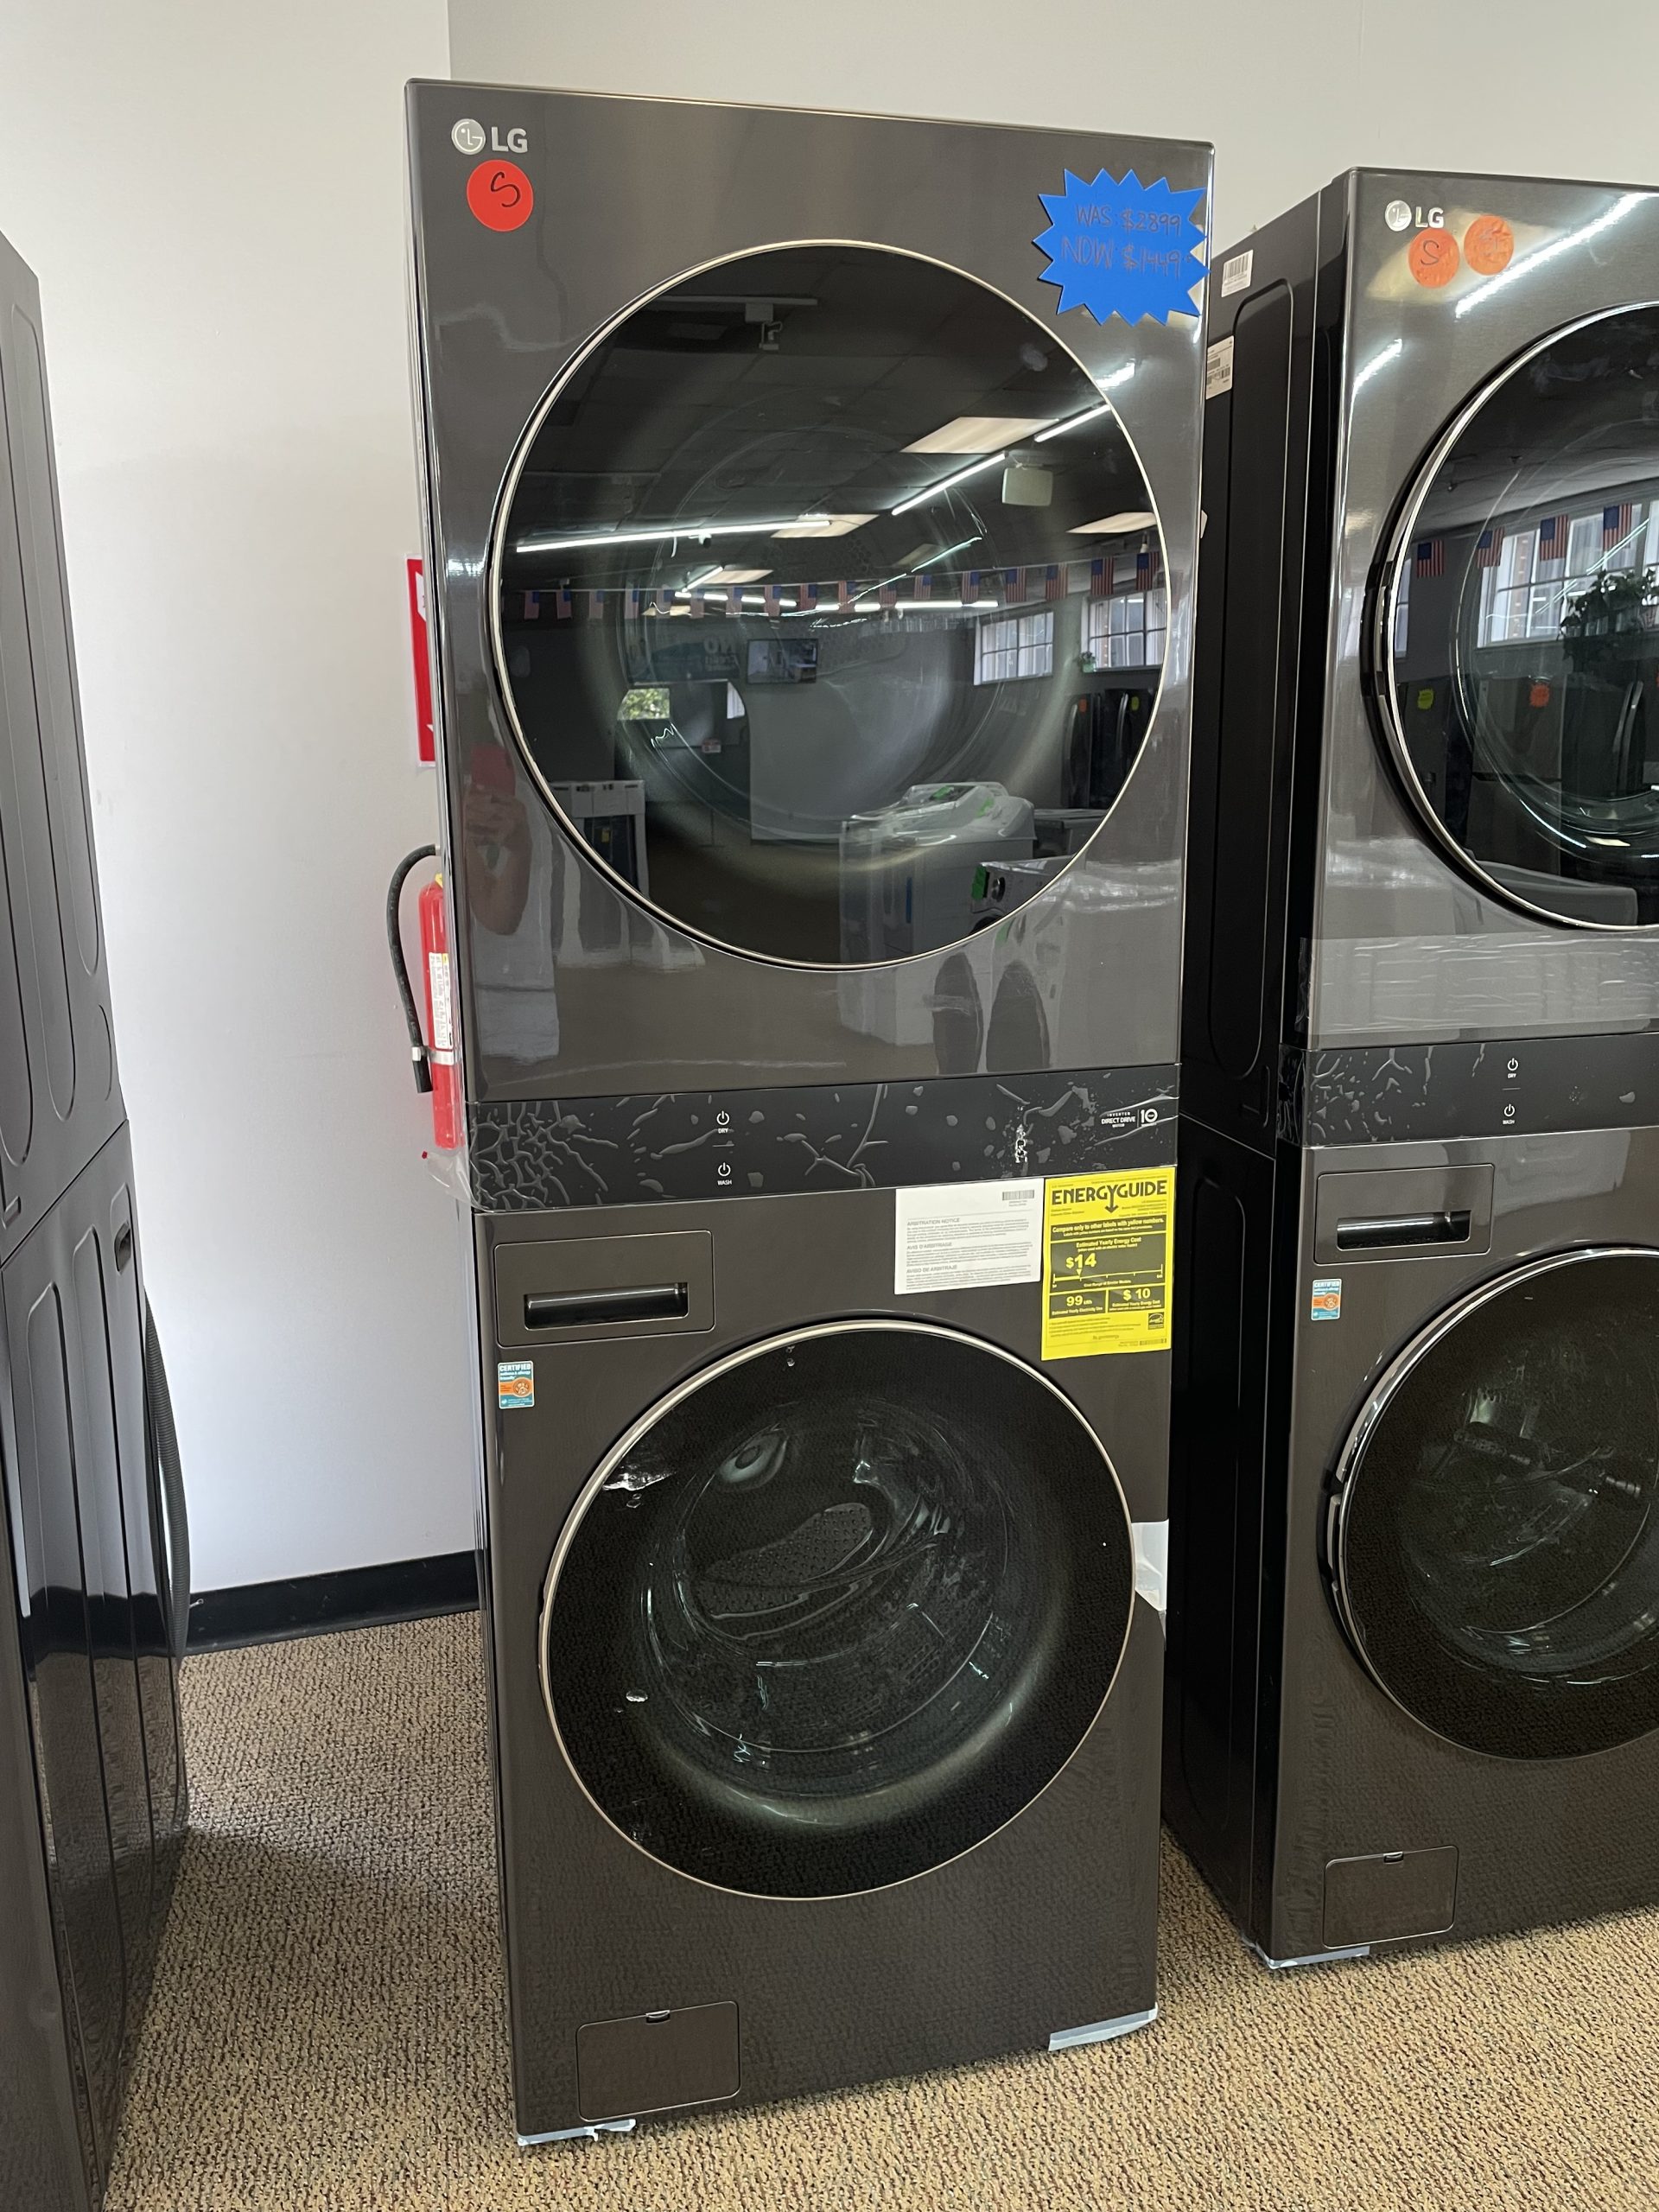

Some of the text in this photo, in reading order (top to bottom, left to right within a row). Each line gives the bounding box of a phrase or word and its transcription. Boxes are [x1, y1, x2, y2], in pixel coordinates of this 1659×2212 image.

[491, 126, 528, 153] LG
[490, 171, 521, 207] S
[1075, 203, 1182, 237] WAS $2899
[1414, 206, 1444, 228] LG
[1061, 236, 1182, 281] NOW $1449
[1420, 239, 1440, 265] S
[1141, 1109, 1158, 1123] 10
[1052, 1179, 1167, 1206] ENERGYGUIDE
[1065, 1253, 1096, 1269] $14
[1066, 1295, 1084, 1306] 99
[1135, 1287, 1151, 1300] 10
[499, 1363, 531, 1372] CERTIFIED
